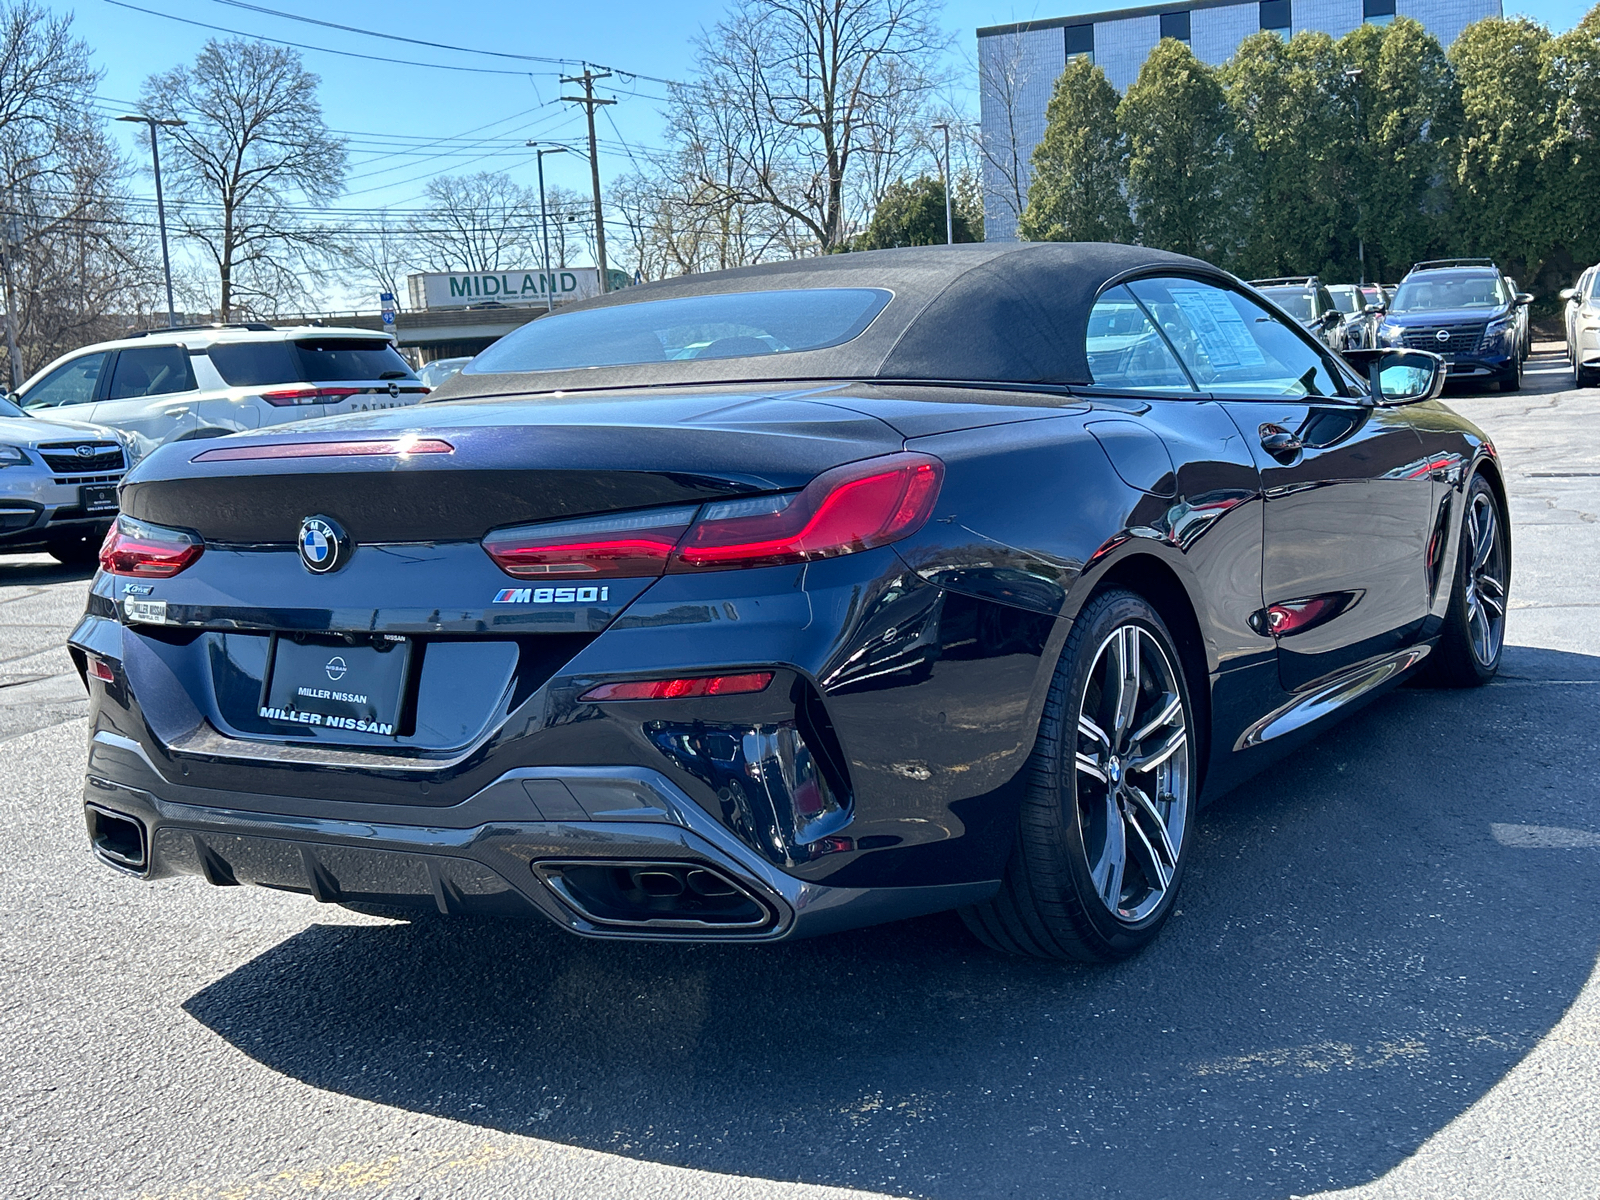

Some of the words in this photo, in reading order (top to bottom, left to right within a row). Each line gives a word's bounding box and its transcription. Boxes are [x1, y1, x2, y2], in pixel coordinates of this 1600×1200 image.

[449, 272, 577, 297] MIDLAND
[383, 313, 395, 322] 95
[384, 634, 406, 642] NISSAN
[325, 664, 348, 672] NISSAN
[298, 687, 331, 699] MILLER
[332, 692, 368, 704] NISSAN
[260, 707, 322, 724] MILLER
[326, 715, 393, 735] NISSAN
